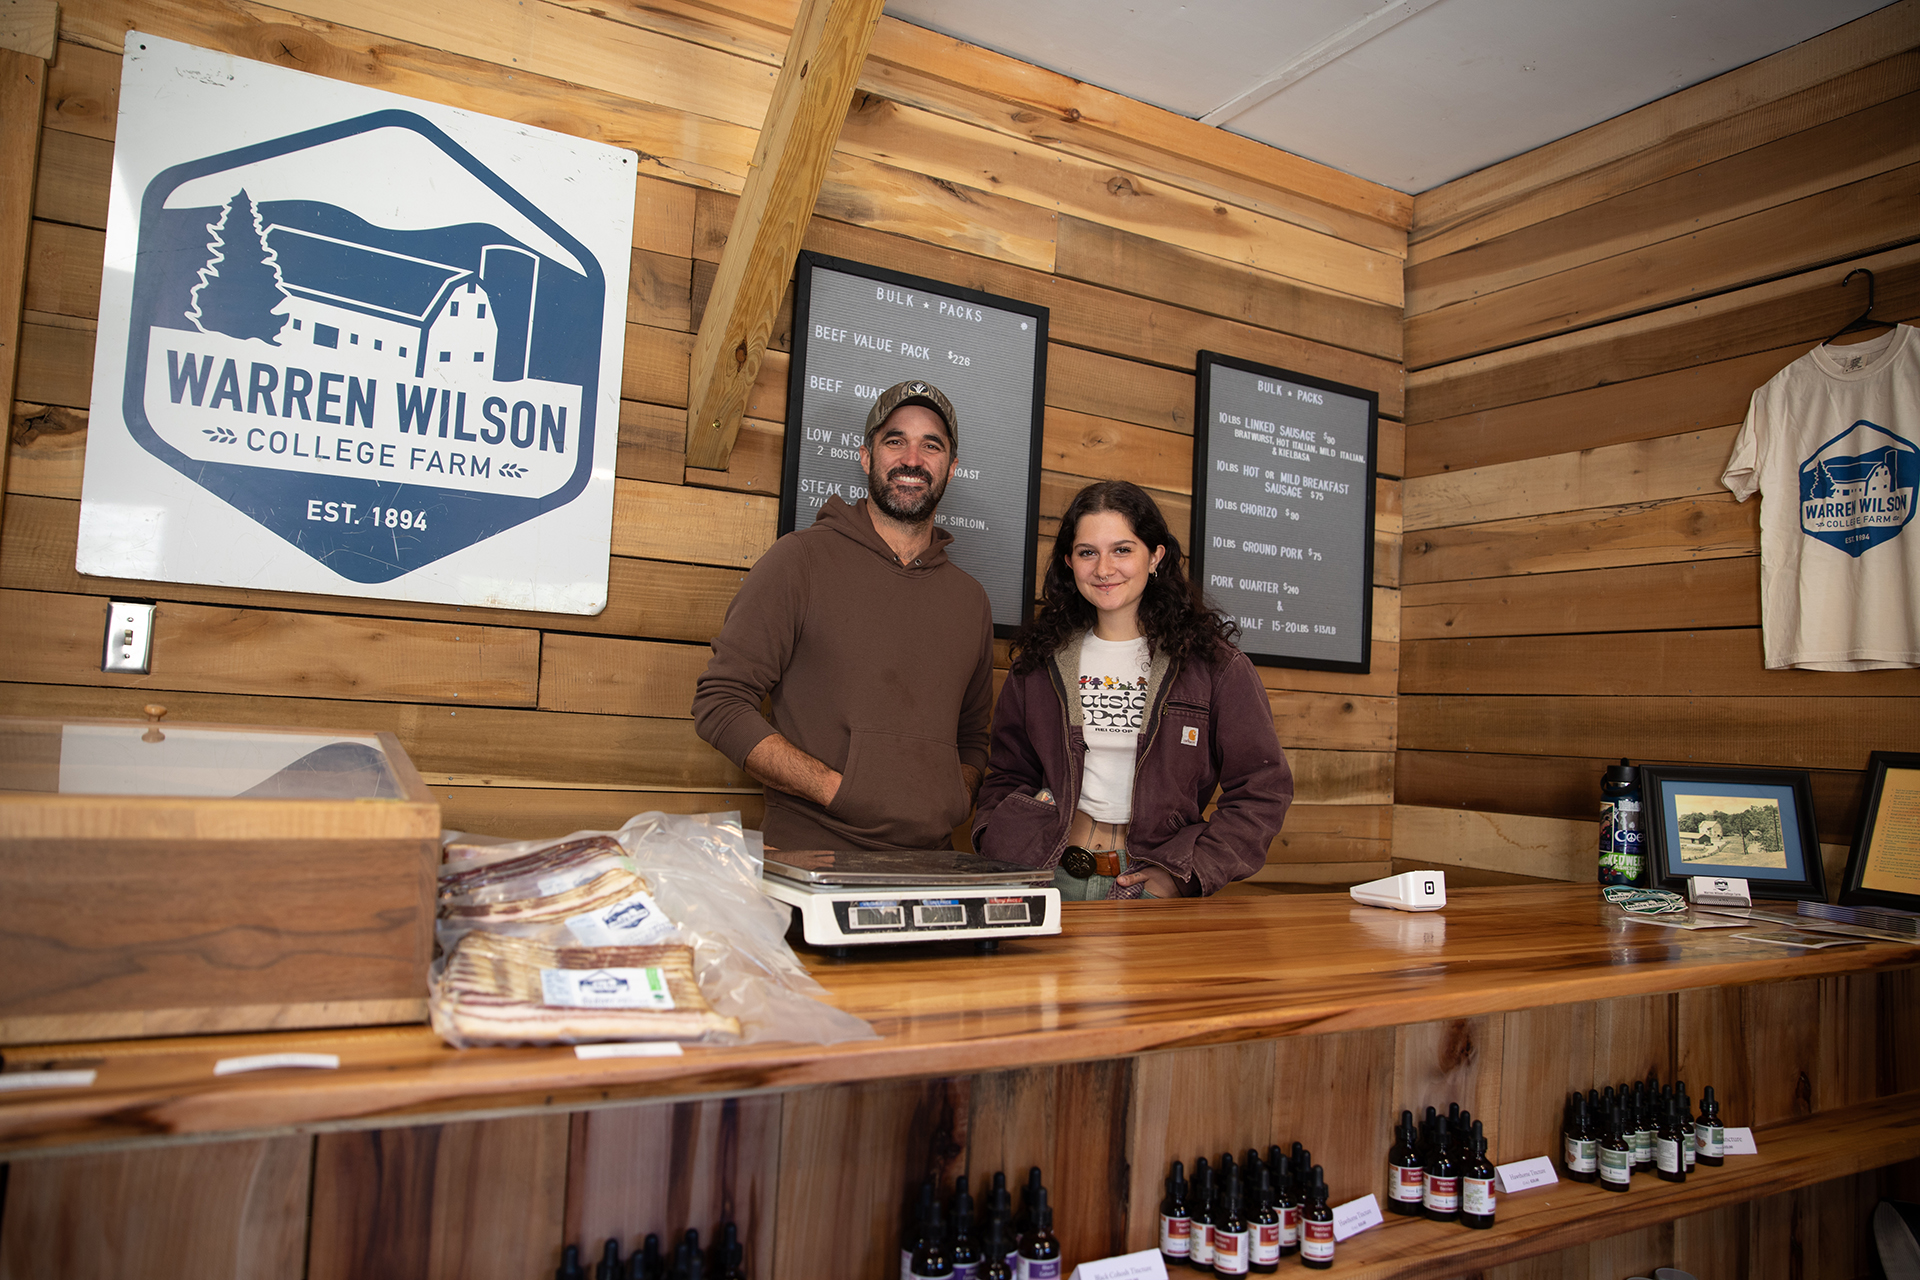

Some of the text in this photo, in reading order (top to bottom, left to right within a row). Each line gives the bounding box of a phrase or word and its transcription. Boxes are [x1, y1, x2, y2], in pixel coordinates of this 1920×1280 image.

[877, 287, 983, 322] BULK PACKS
[815, 325, 971, 367] BEEF VALUE PACK $226
[810, 376, 843, 393] BEEF
[1258, 380, 1323, 405] BULK PACKS
[167, 349, 568, 453] WARREN WILSON
[807, 427, 832, 443] LOW
[1245, 418, 1275, 434] LINKED
[1280, 425, 1316, 443] SAUSAGE
[245, 427, 491, 479] COLLEGE FARM
[817, 446, 861, 461] 2 BOSTO
[1272, 447, 1310, 462] & KIELBASA
[1276, 438, 1289, 448] HOT
[1319, 447, 1335, 458] MILD
[800, 479, 842, 497] STEAK
[1243, 465, 1260, 478] HOT
[1265, 470, 1275, 480] OR
[1280, 472, 1300, 485] MILD
[1303, 476, 1349, 495] BREAKFAST
[1264, 482, 1324, 501] SAUSAGE $75
[306, 499, 427, 532] EST. 1894
[1240, 502, 1277, 519] CHORIZO
[1806, 494, 1907, 519] WARREN WILSON
[1826, 515, 1891, 528] COLLEGE FARM
[1242, 541, 1277, 556] GROUND
[1280, 546, 1303, 560] PORK
[1308, 548, 1322, 561] $75
[1211, 574, 1234, 589] PORK
[1239, 579, 1279, 594] QUARTER
[1277, 601, 1283, 612] &
[1240, 617, 1264, 630] HALF
[1614, 830, 1645, 842] Coe
